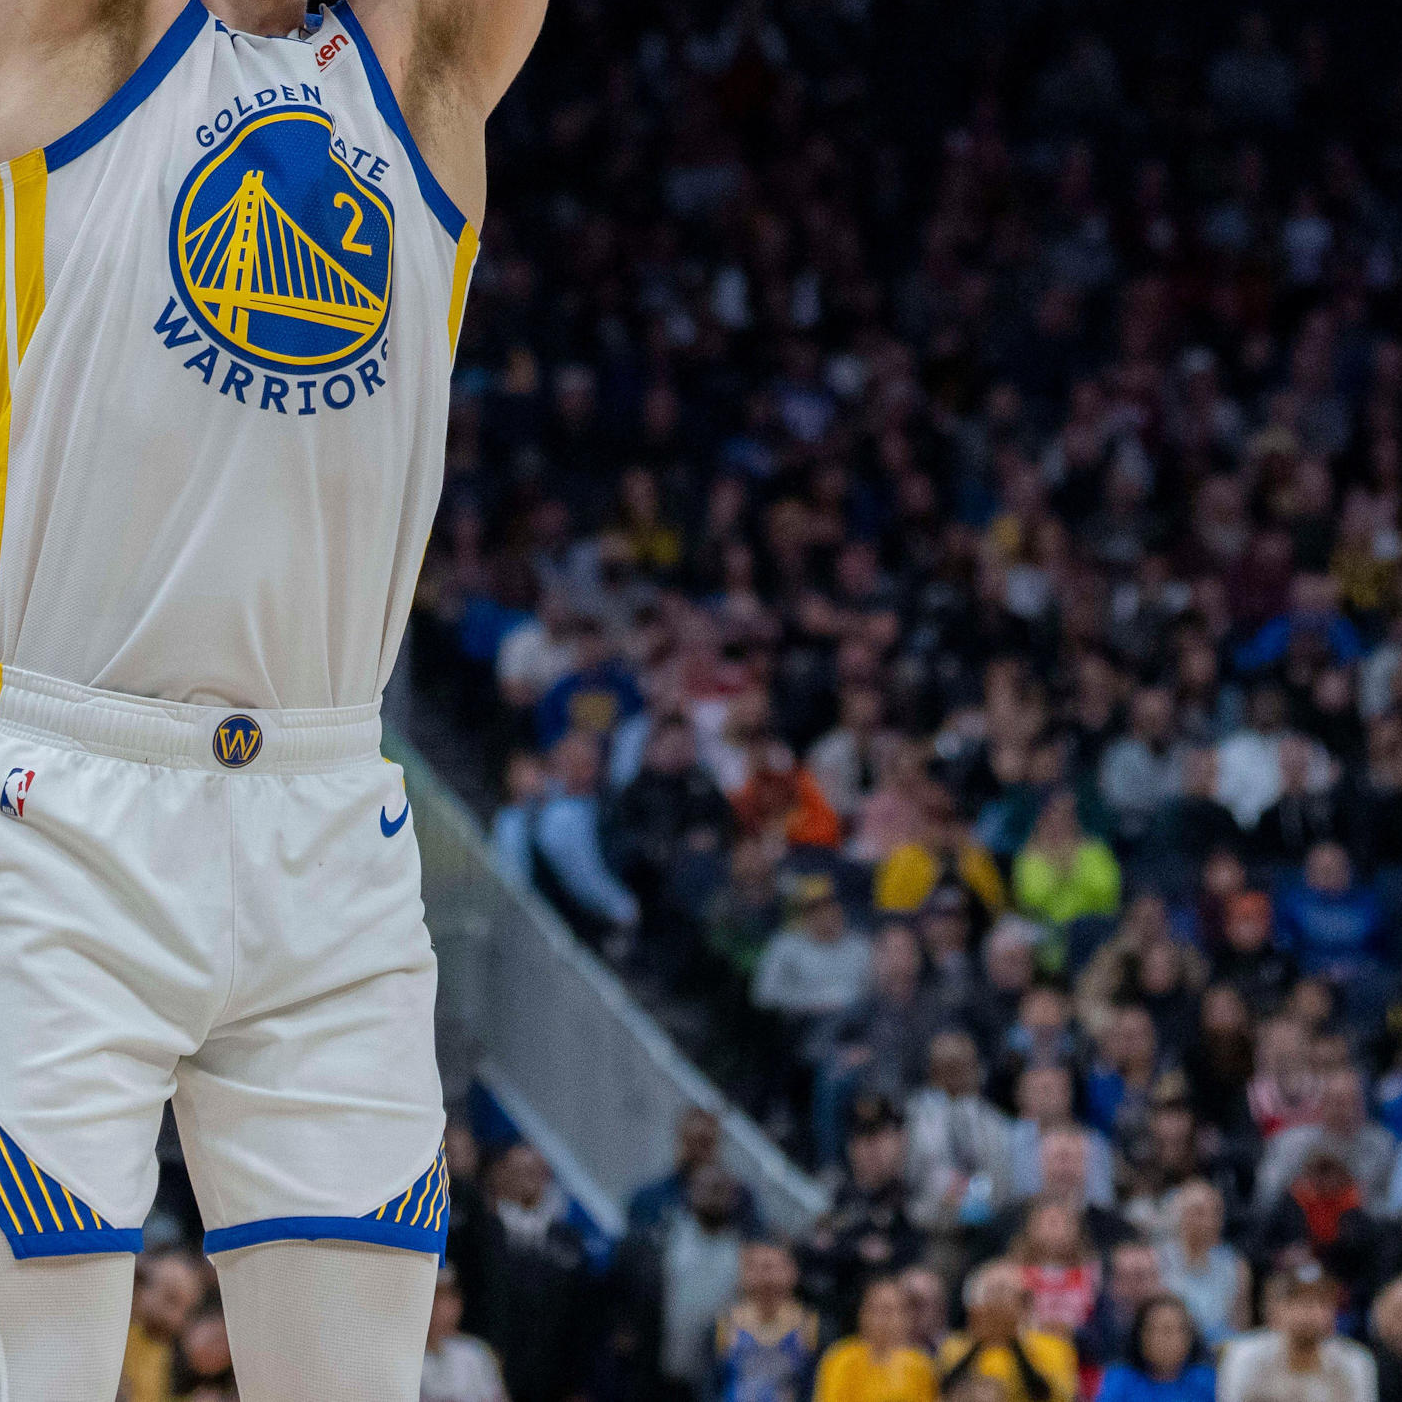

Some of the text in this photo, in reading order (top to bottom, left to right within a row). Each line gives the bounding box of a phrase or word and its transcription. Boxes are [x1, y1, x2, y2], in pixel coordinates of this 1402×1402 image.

[196, 83, 391, 182] GOLDEN ATE
[333, 192, 373, 257] 2
[218, 728, 261, 761] W
